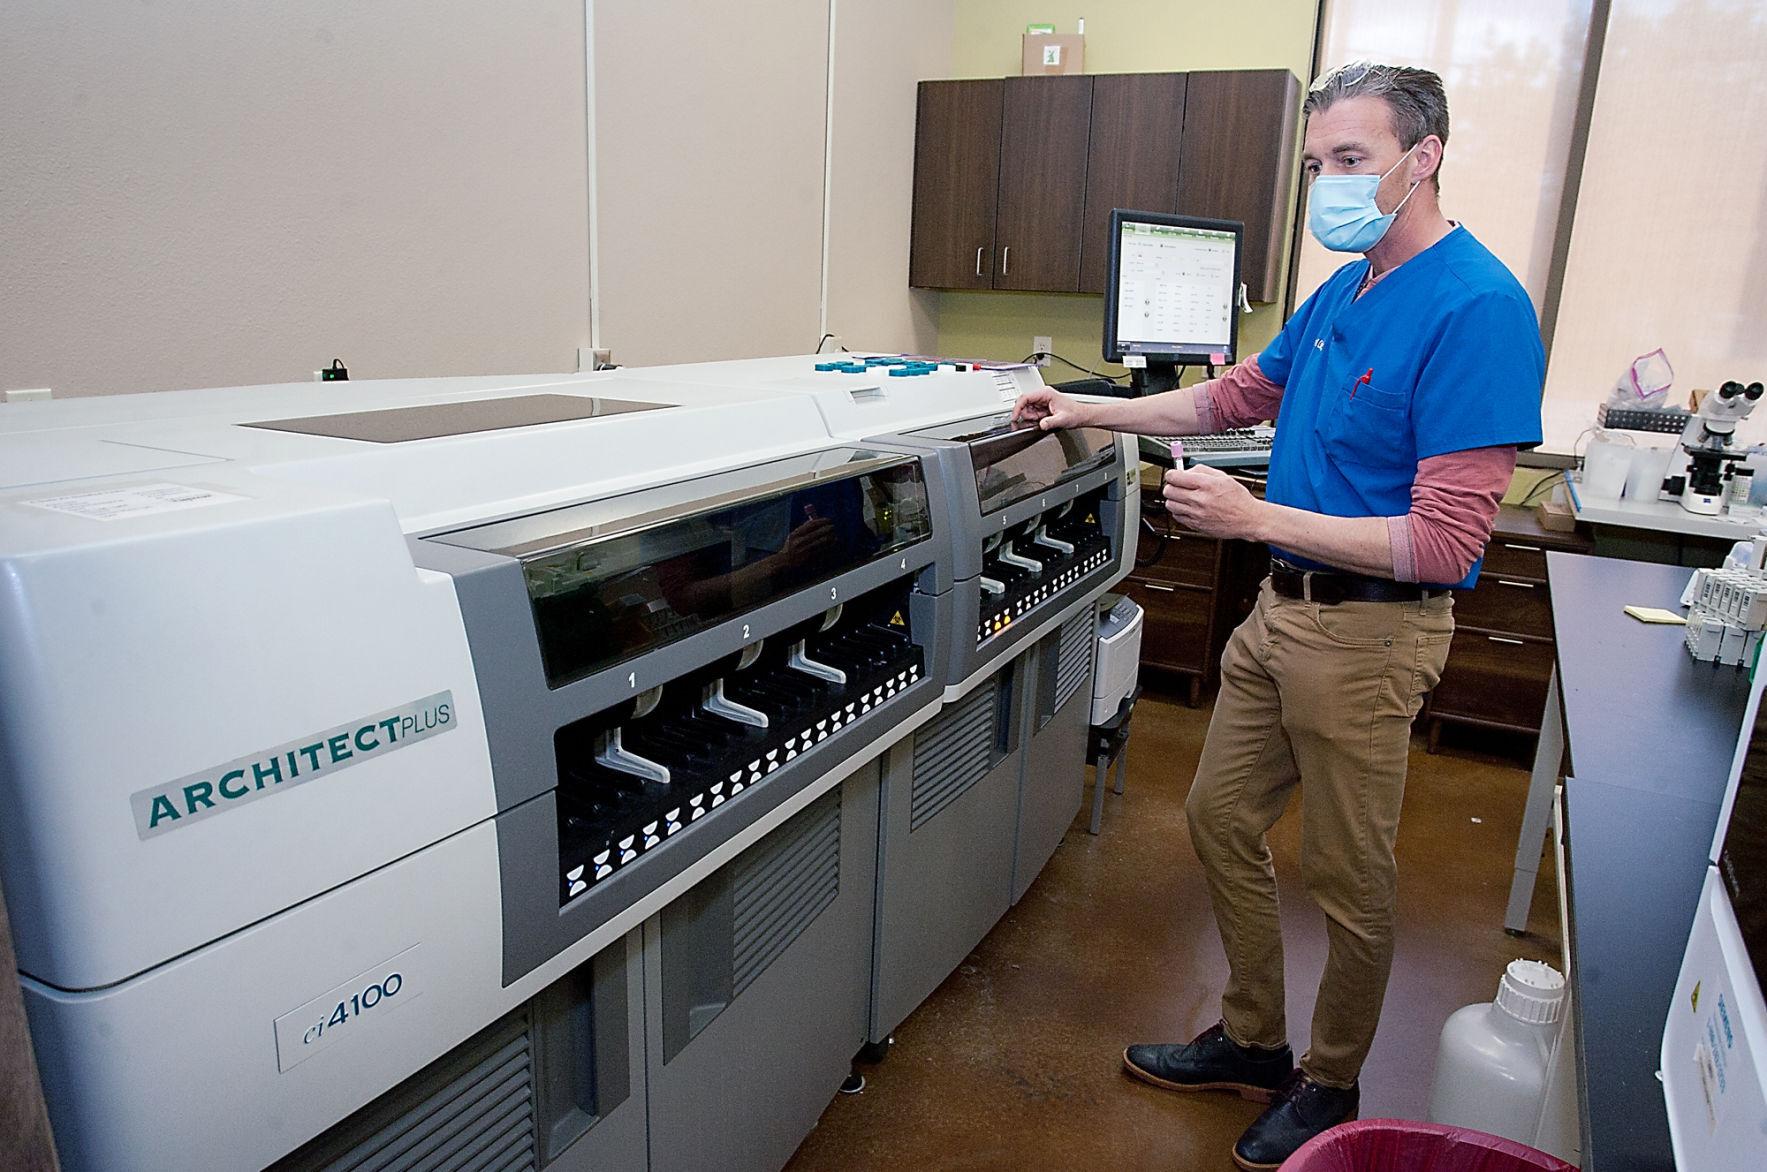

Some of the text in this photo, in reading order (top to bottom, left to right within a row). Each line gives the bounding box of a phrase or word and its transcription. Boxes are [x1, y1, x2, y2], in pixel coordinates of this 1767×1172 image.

[1002, 515, 1007, 525] 5
[900, 558, 906, 569] 4
[831, 587, 837, 600] 3
[743, 624, 750, 638] 2
[628, 672, 635, 688] 1
